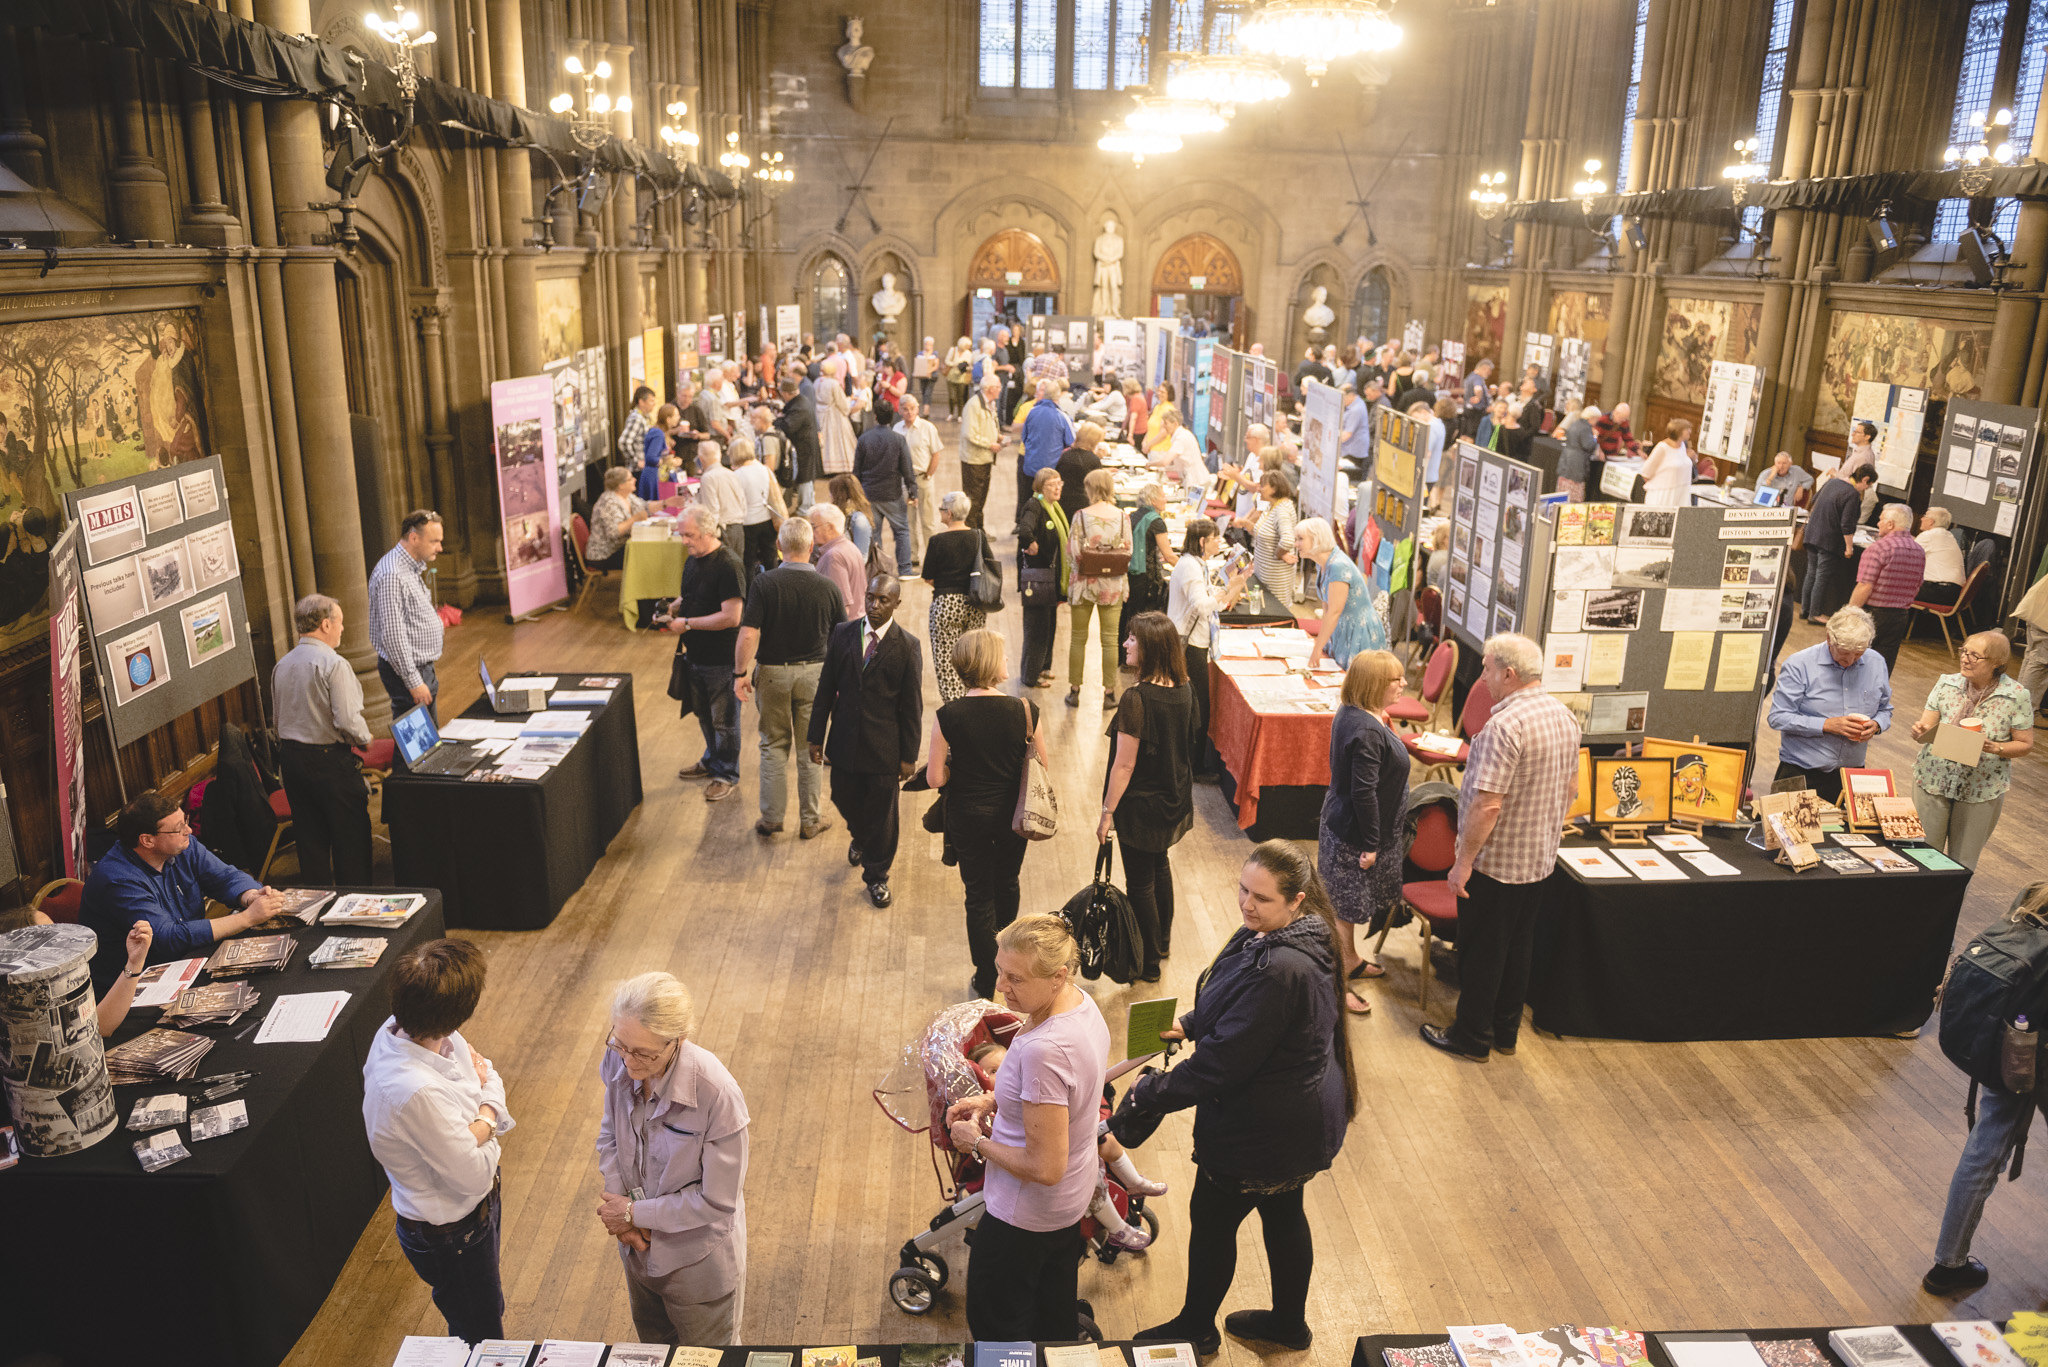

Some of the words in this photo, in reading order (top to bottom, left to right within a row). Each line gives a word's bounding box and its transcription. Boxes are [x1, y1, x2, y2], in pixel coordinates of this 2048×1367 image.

[88, 502, 132, 531] MMHS
[90, 580, 113, 592] Previous
[112, 575, 125, 584] talks
[104, 583, 127, 595] included:
[123, 638, 136, 648] Military
